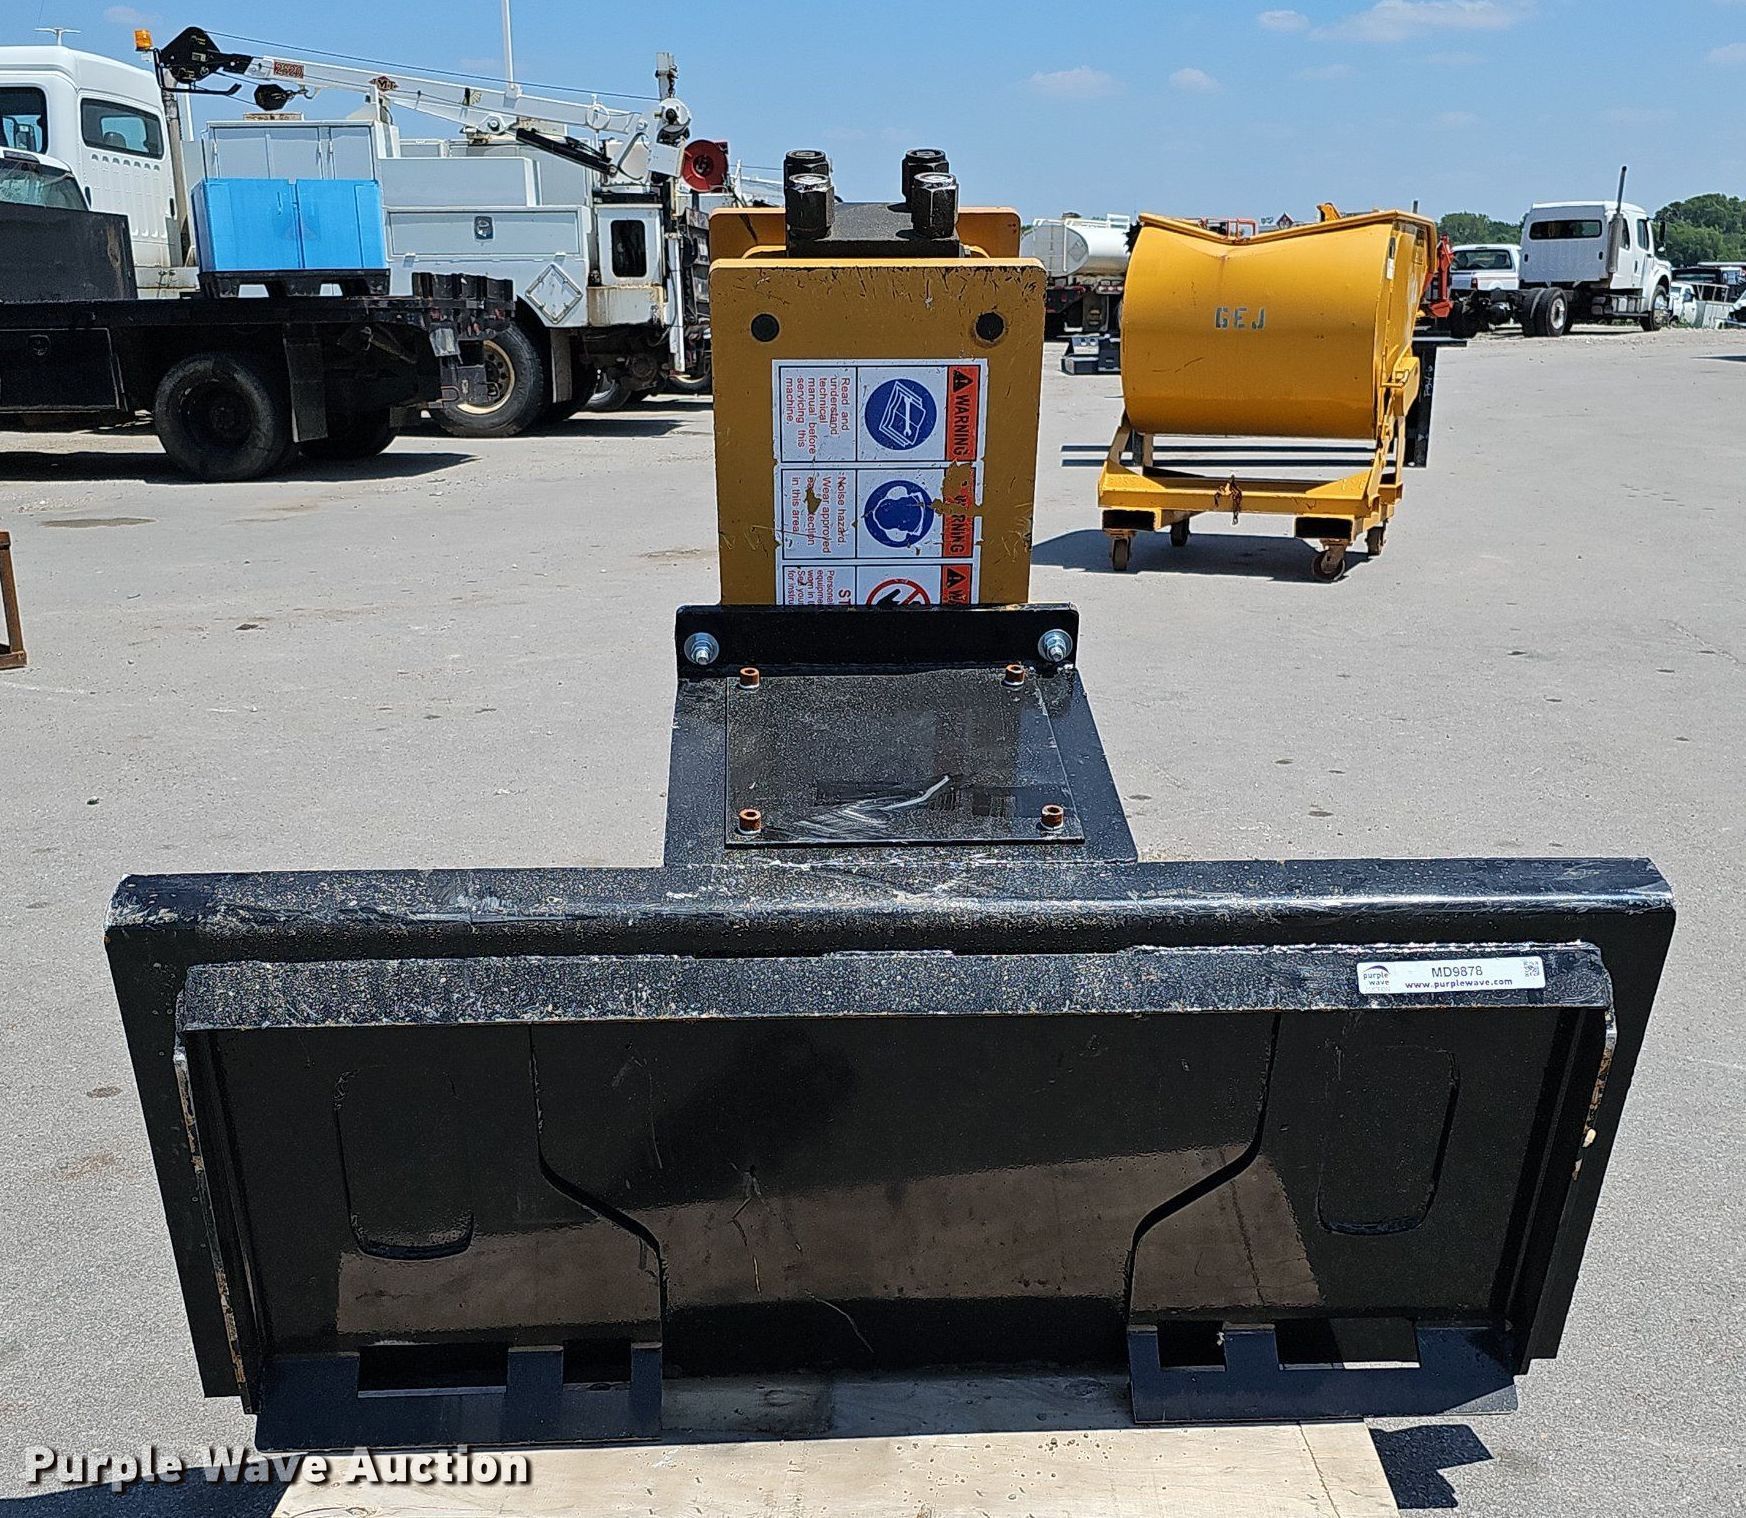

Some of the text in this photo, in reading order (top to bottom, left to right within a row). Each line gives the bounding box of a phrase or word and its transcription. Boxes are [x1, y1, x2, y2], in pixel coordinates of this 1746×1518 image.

[1216, 307, 1265, 330] GEJ
[786, 378, 795, 424] machine.
[796, 377, 806, 447] servicing this
[808, 378, 817, 454] manual before
[820, 378, 828, 423] technical
[830, 378, 839, 435] understand
[841, 378, 850, 430] Read and
[953, 394, 970, 456] WARNING
[792, 477, 800, 485] in
[792, 489, 800, 506] this
[820, 476, 831, 553] Wear approved
[837, 476, 846, 546] Noise hazard.
[950, 494, 966, 553] WRNING
[788, 570, 796, 582] for
[808, 591, 815, 599] in
[1363, 972, 1389, 980] purple
[1404, 979, 1513, 989] www.purplewave.com
[1431, 966, 1483, 978] MD9878
